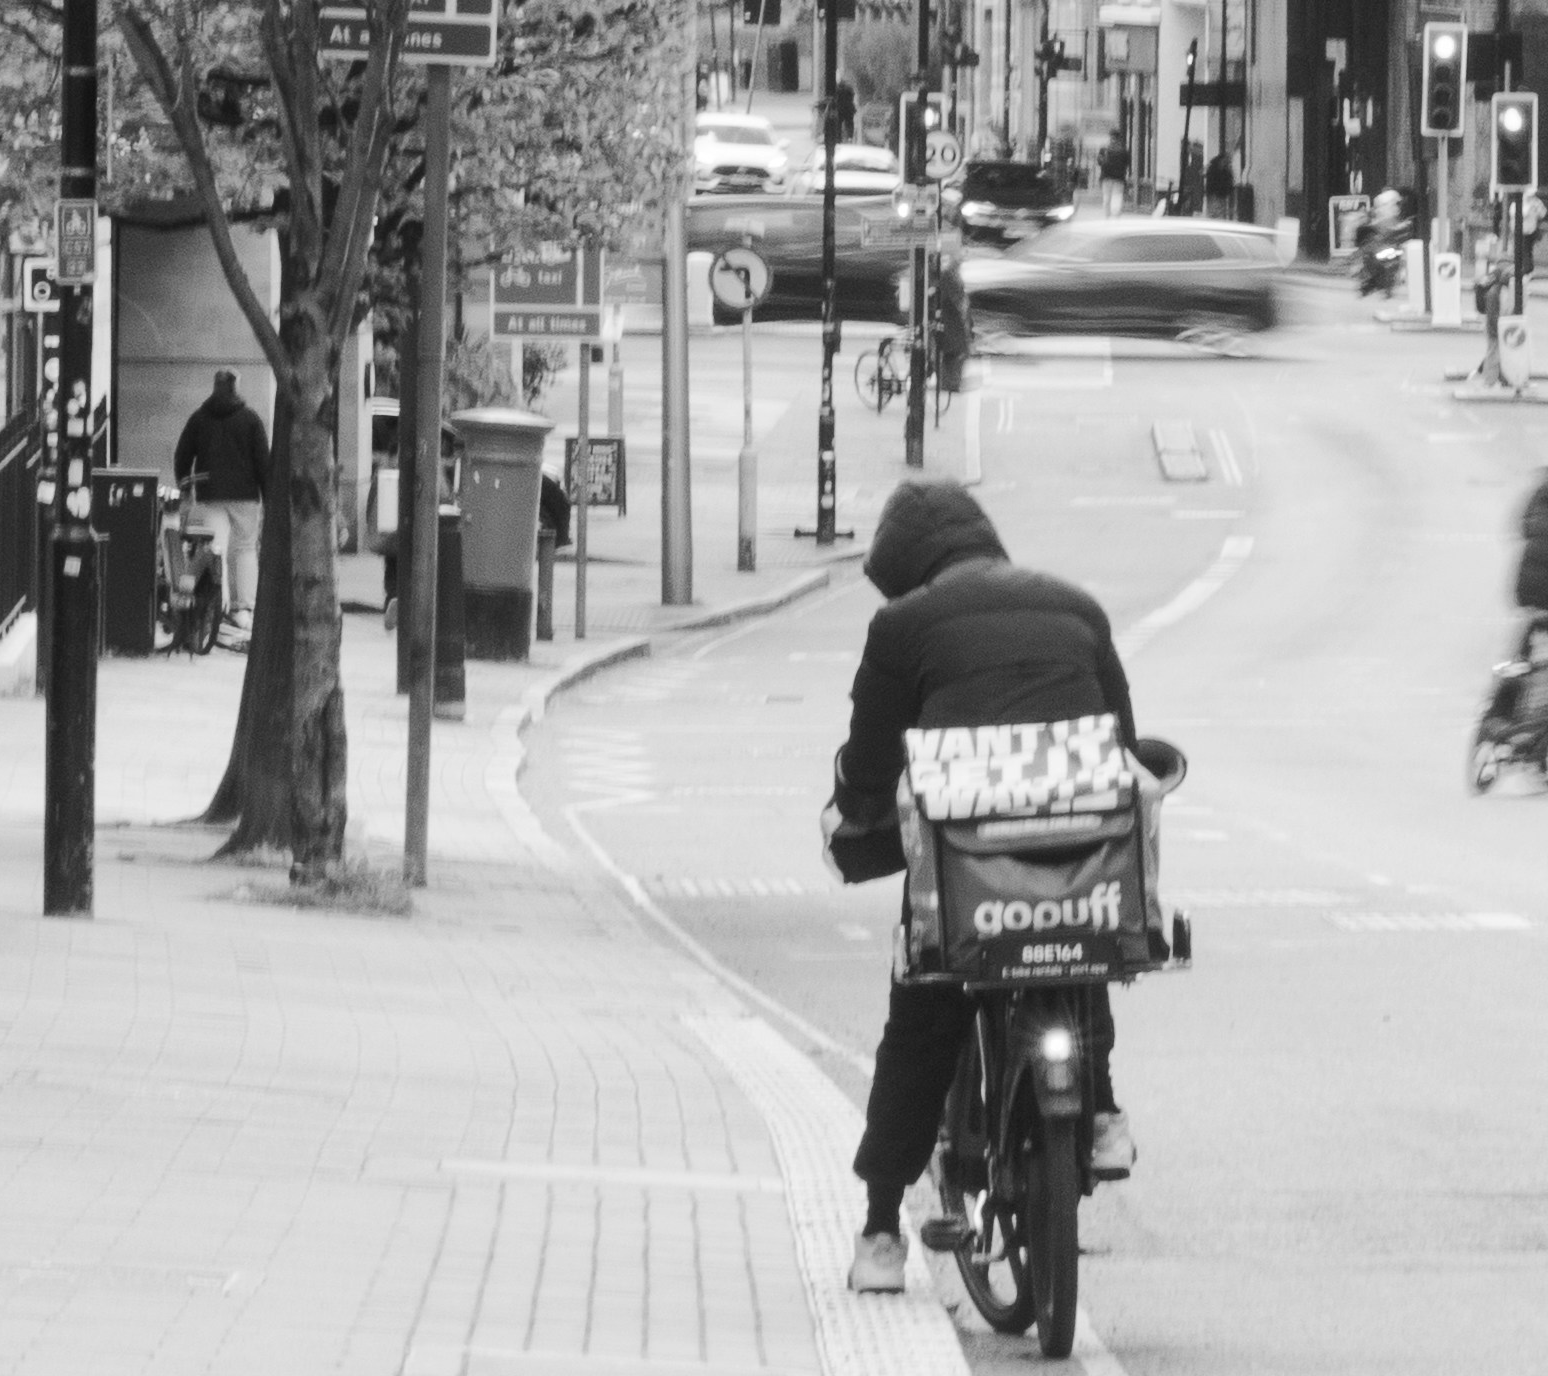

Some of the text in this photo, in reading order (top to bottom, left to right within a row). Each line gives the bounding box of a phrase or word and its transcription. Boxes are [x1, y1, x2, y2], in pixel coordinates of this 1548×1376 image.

[507, 315, 587, 333] At all times
[973, 879, 1122, 940] gopuff
